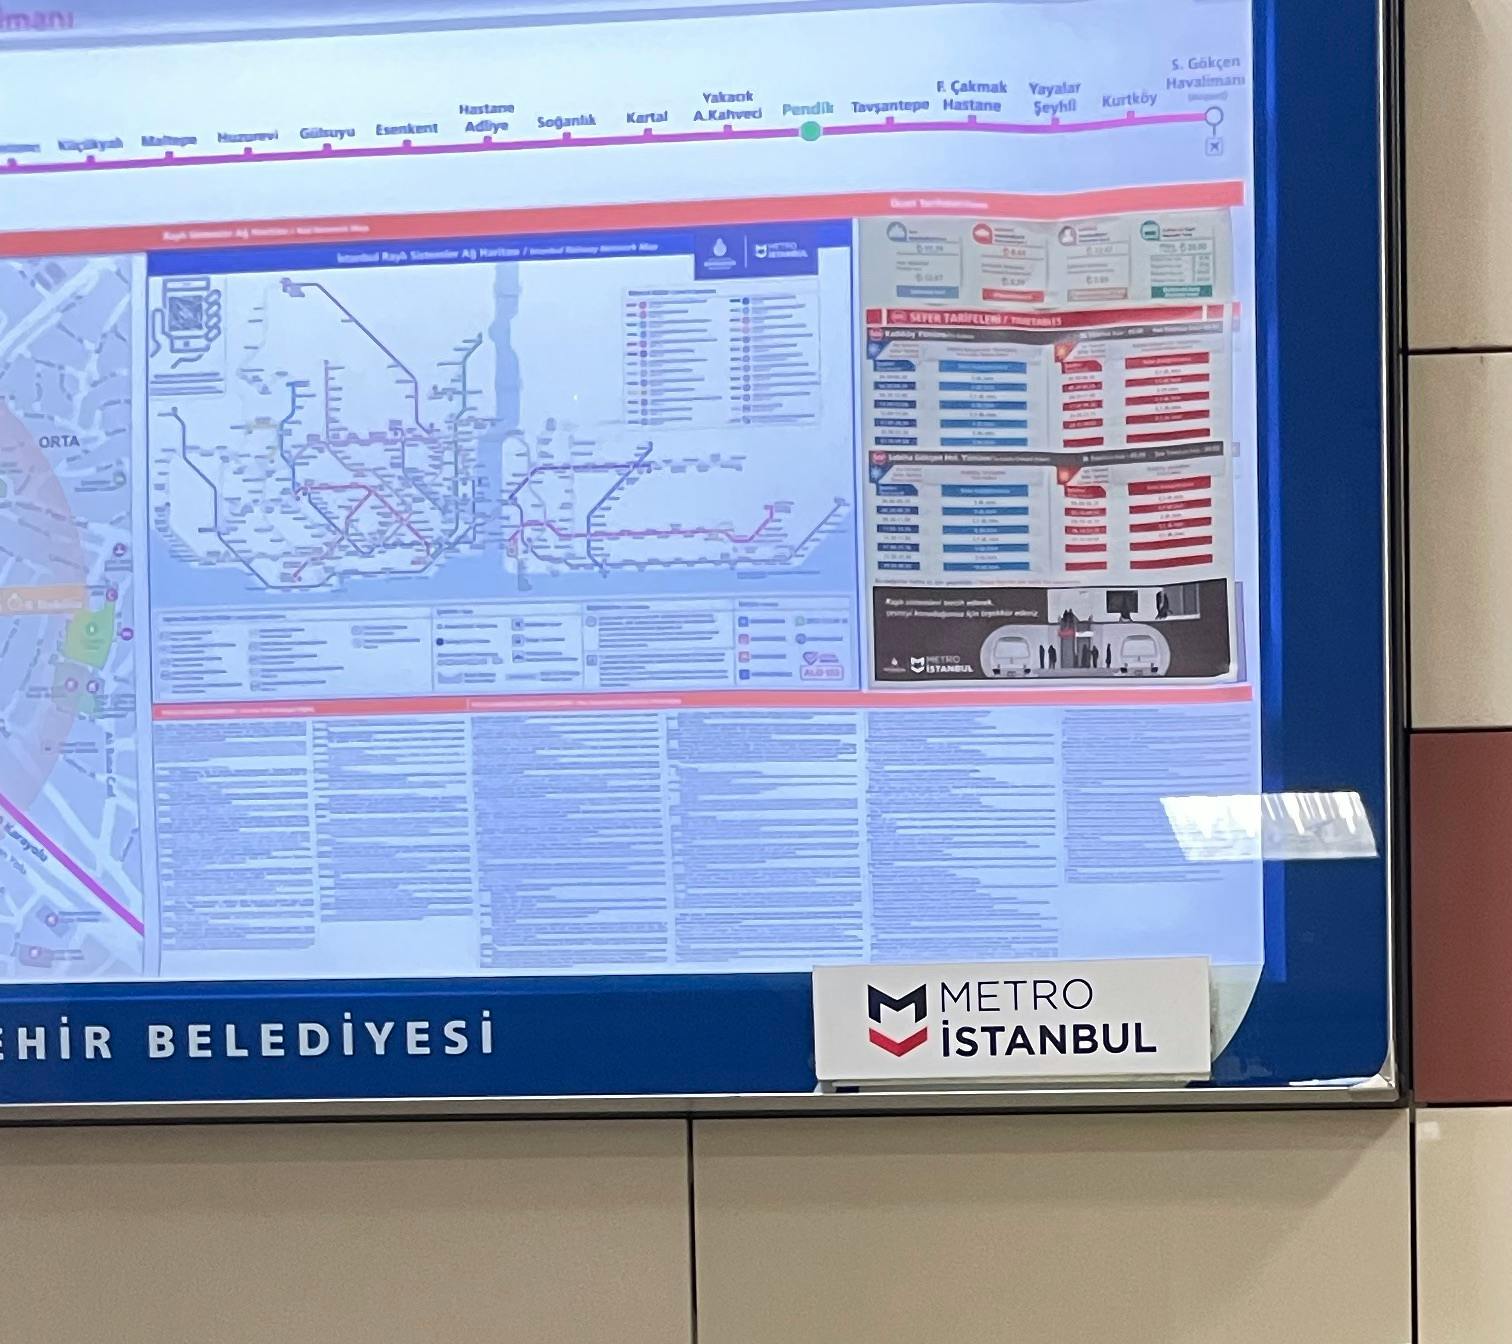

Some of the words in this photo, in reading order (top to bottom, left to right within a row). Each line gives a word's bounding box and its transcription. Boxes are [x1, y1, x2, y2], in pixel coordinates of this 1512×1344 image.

[1188, 56, 1241, 71] Gökçen
[950, 80, 1008, 95] Çakmak
[1029, 82, 1081, 98] Yayalar
[943, 98, 1002, 112] Hastane
[1102, 92, 1158, 107] Kurtköy
[459, 104, 515, 115] Hastane
[782, 101, 834, 116] Pendik
[851, 101, 930, 115] Tavşantepe
[626, 110, 668, 124] Kartal
[376, 123, 439, 136] Esenkent
[38, 434, 81, 448] ORTA
[940, 978, 1094, 1013] METRO
[0, 1015, 112, 1060] HİR
[147, 1009, 494, 1059] BELEDİYESİ
[942, 1019, 1158, 1058] İSTANBUL
